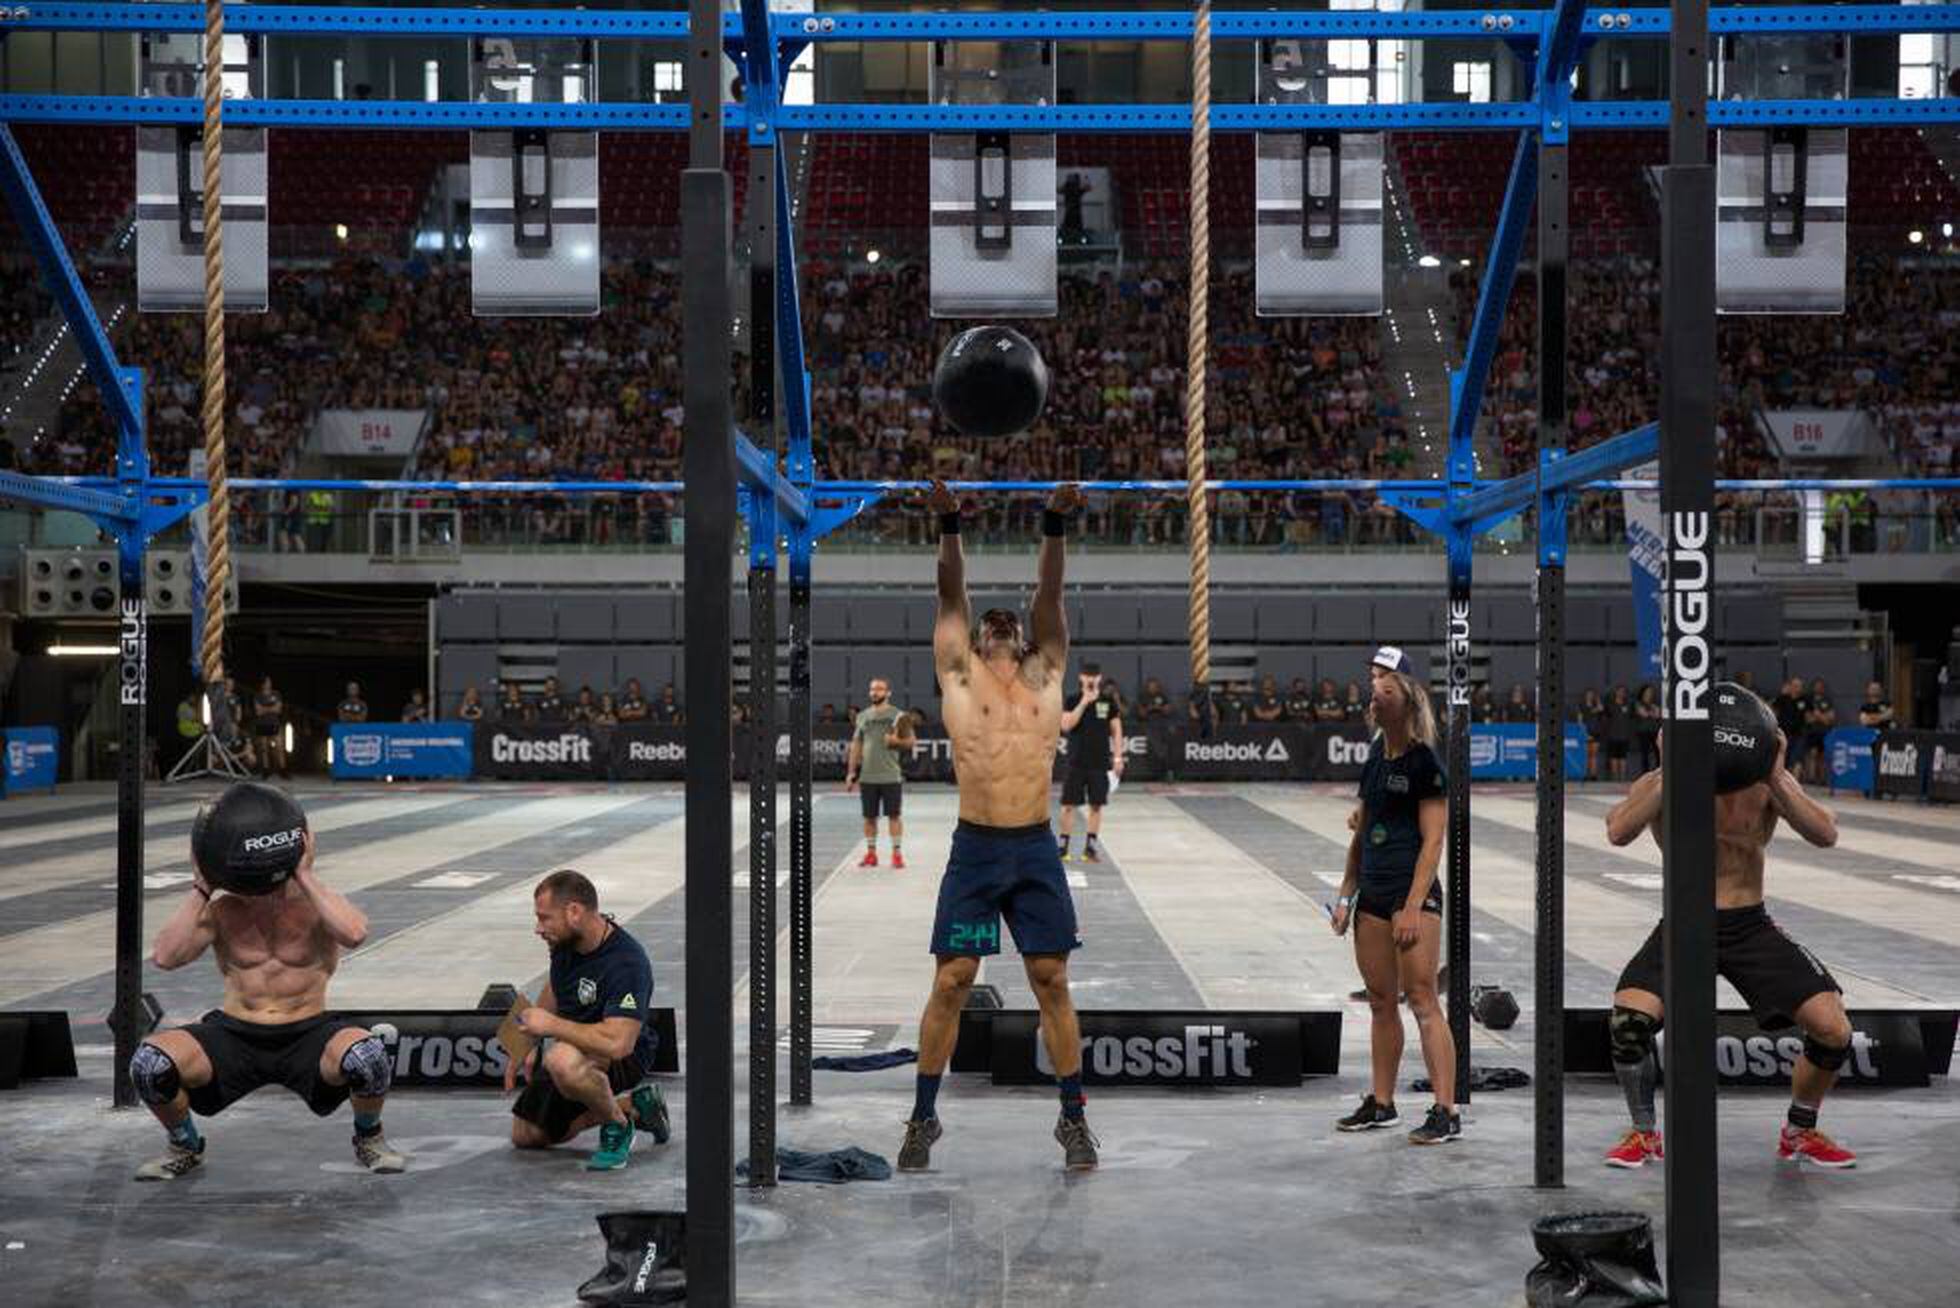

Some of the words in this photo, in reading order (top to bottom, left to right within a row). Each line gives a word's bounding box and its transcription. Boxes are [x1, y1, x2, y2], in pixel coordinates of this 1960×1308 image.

[1674, 511, 1709, 720] ROGUE
[121, 599, 139, 705] ROGUE
[1451, 600, 1470, 705] ROGUE
[492, 734, 591, 762] CrossFit
[629, 741, 687, 760] Reeb
[912, 738, 951, 760] FIT
[1185, 742, 1262, 761] Reebok
[1714, 730, 1755, 748] ROG
[951, 921, 998, 948] 244
[633, 1241, 657, 1293] ROGUE
